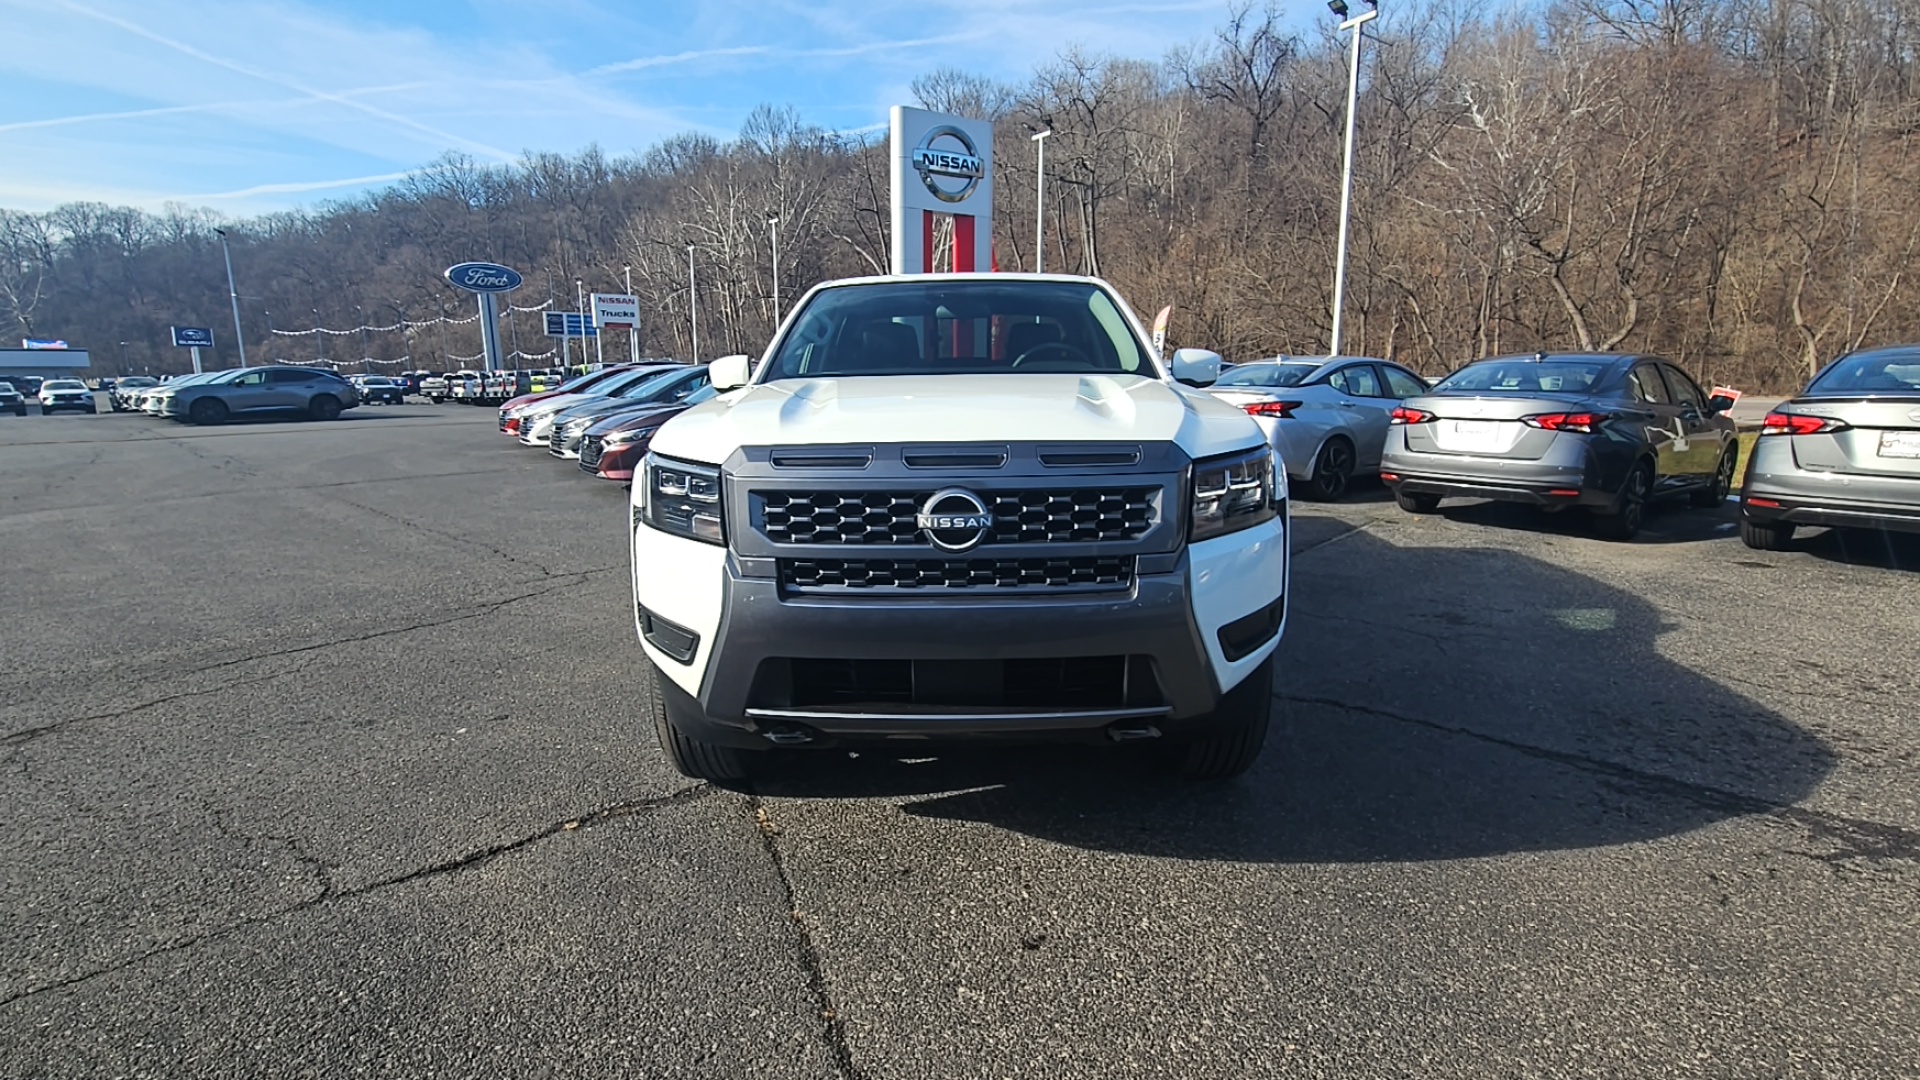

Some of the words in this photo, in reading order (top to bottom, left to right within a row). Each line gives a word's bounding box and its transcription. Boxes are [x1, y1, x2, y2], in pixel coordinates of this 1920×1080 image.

[922, 153, 980, 173] NISSAN
[464, 268, 508, 286] Ford
[598, 297, 635, 305] NISSAN
[600, 309, 635, 318] Trucks
[919, 517, 992, 528] NISSAN
